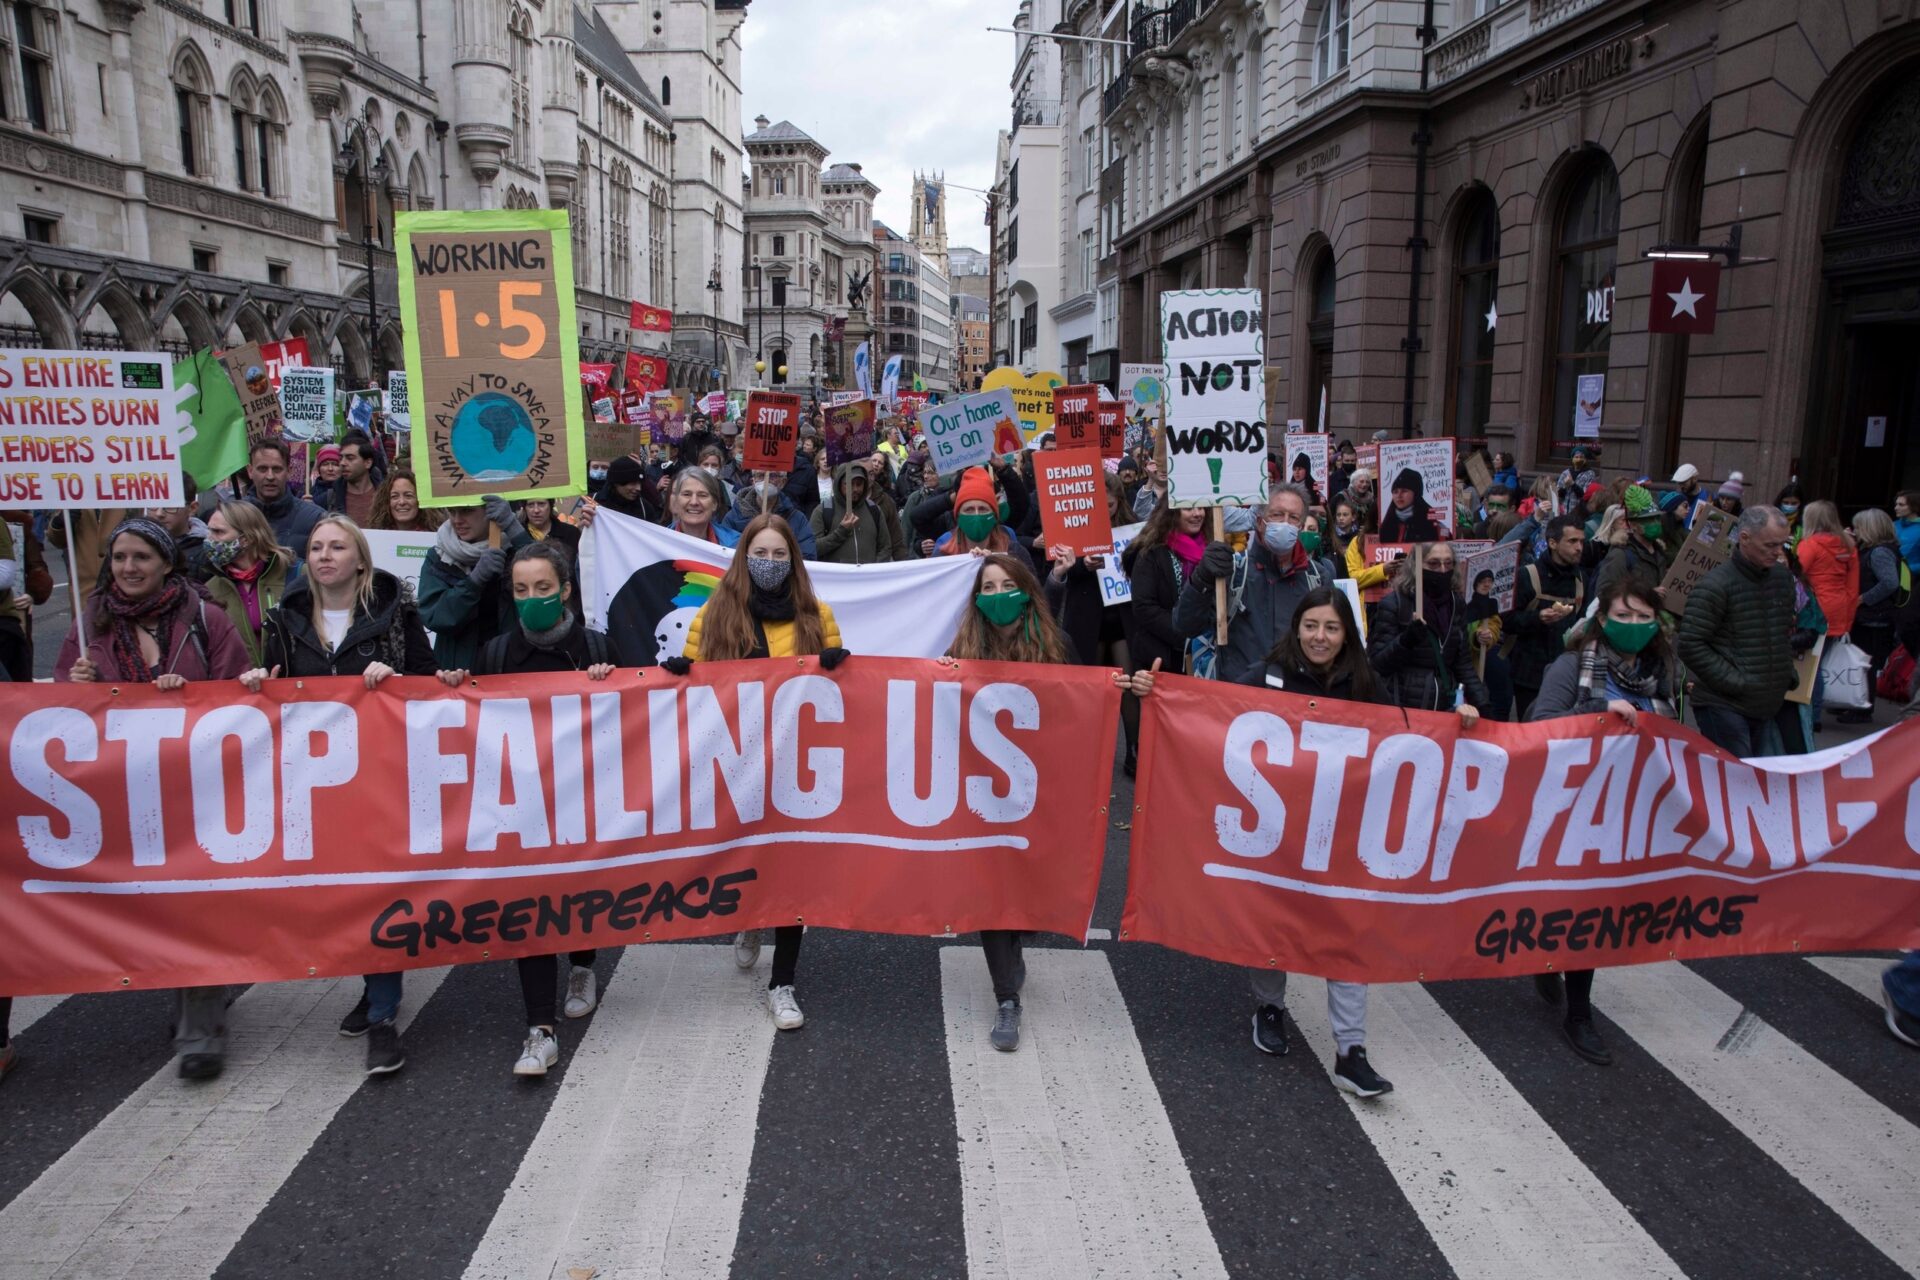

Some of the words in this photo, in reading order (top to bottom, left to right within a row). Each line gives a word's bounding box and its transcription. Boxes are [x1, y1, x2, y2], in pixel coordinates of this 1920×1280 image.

[1311, 144, 1341, 170] STRAND
[412, 239, 545, 276] WORKING
[1167, 308, 1263, 341] ACTION
[22, 356, 115, 388] ENTIRE
[1179, 360, 1261, 396] NOT
[284, 376, 323, 386] SYSTEM
[479, 373, 507, 390] TO
[284, 385, 326, 395] CHANGE
[284, 394, 304, 402] NOT
[449, 374, 475, 411] WAY
[1011, 388, 1032, 396] ere's
[1056, 388, 1073, 397] WORLD
[285, 403, 327, 413] CLIMATE
[511, 382, 545, 420] SAVE
[1015, 401, 1042, 413] net
[1063, 398, 1088, 413] STOP
[92, 399, 160, 427] BURN
[285, 411, 326, 420] CHANGE
[434, 412, 452, 428] A
[759, 407, 788, 425] STOP
[930, 414, 961, 436] Our
[964, 401, 1003, 424] home
[1058, 411, 1094, 427] FAILING
[1099, 413, 1117, 425] TOP
[538, 416, 550, 430] A
[1071, 425, 1085, 438] US
[750, 423, 792, 442] FAILING
[1166, 420, 1266, 455] WORDS
[105, 435, 175, 464] STILL
[762, 441, 778, 456] US
[937, 441, 953, 456] is
[960, 430, 982, 448] on
[433, 431, 465, 488] WHAT
[527, 432, 555, 489] PLANET
[1046, 465, 1093, 480] DEMAND
[1423, 469, 1446, 479] ACTION
[51, 473, 84, 501] TO
[95, 472, 170, 501] LEARN
[1049, 481, 1095, 496] CLIMATE
[1055, 497, 1094, 513] ACTION
[1064, 514, 1089, 528] NOW
[9, 700, 359, 870] STOP
[405, 675, 844, 854] FAILING
[887, 679, 1041, 827] US
[1214, 710, 1509, 882] STOP
[1517, 734, 1878, 871] FAILING
[371, 868, 758, 957] GREENPEACE
[1475, 894, 1759, 964] GREENPEACE
